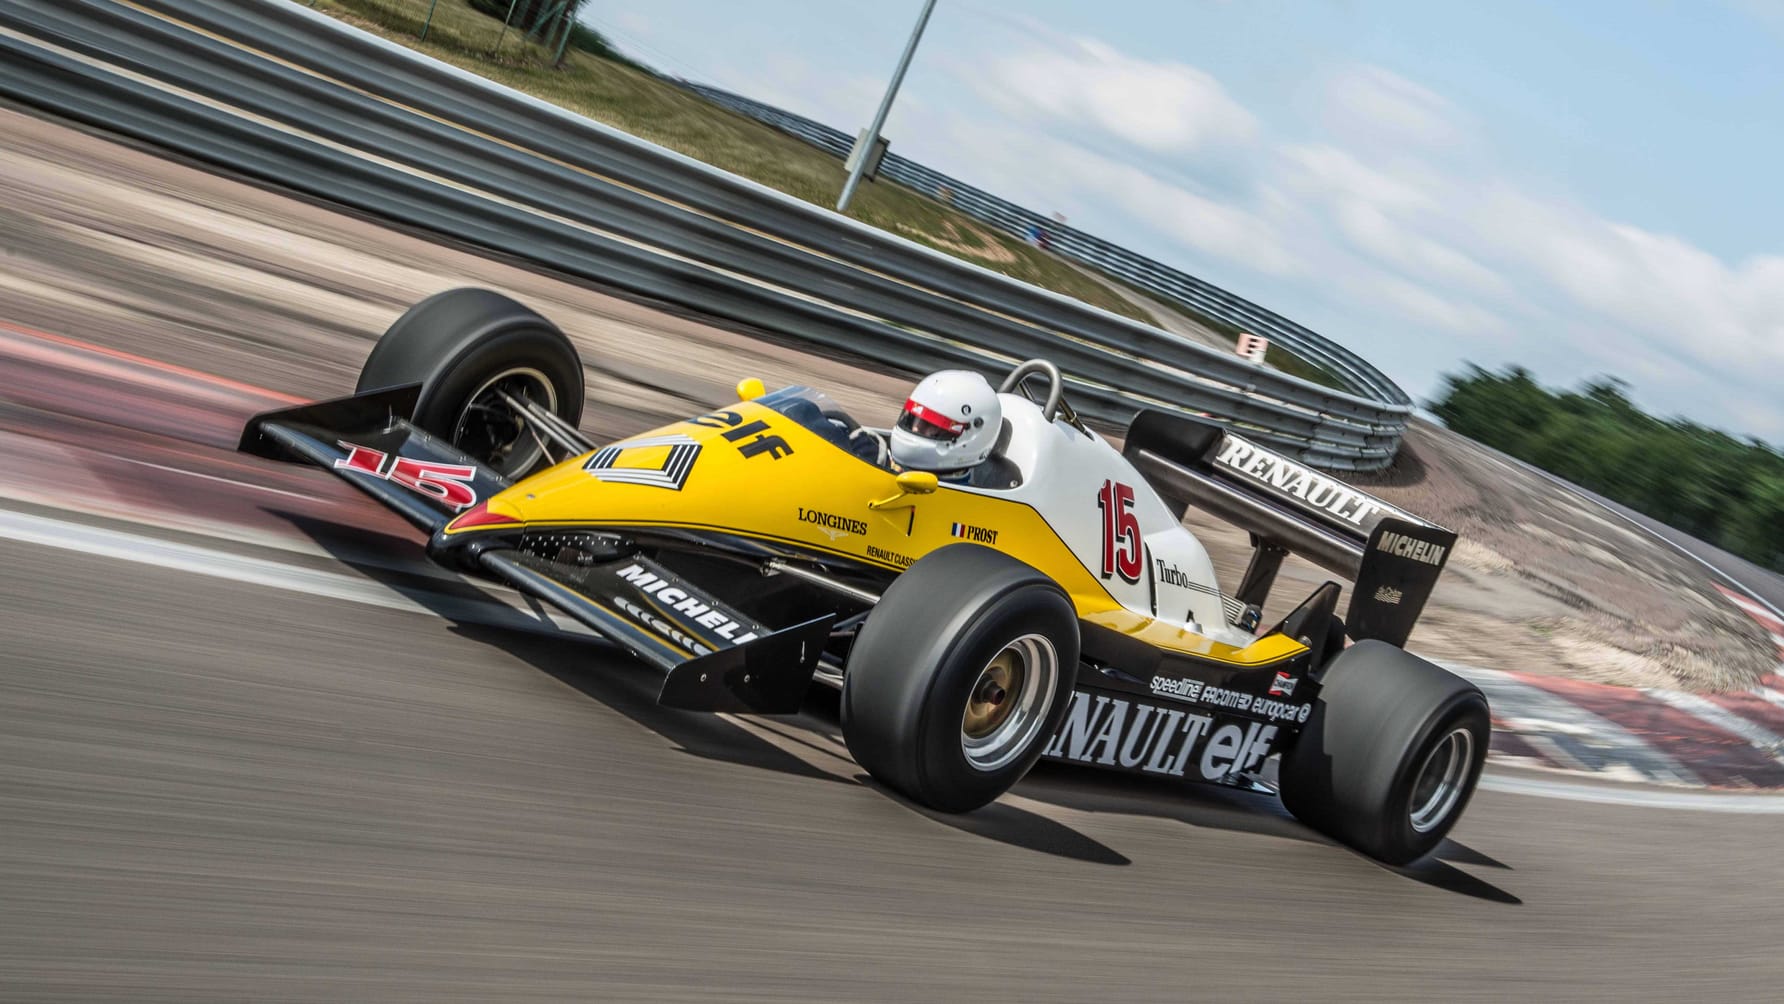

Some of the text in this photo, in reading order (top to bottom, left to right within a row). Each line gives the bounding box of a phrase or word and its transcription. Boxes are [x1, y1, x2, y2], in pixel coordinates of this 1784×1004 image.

[687, 411, 794, 460] elf
[334, 439, 477, 514] 15
[1216, 435, 1380, 525] RENAULT
[798, 507, 868, 536] LONGINES
[966, 525, 998, 545] PROST
[1098, 479, 1143, 585] 15
[867, 545, 895, 562] RENAULT
[1376, 531, 1446, 566] MICHELIN
[1156, 558, 1188, 589] Turbo
[1252, 697, 1300, 722] europcar
[1041, 690, 1279, 780] NAULT elf
